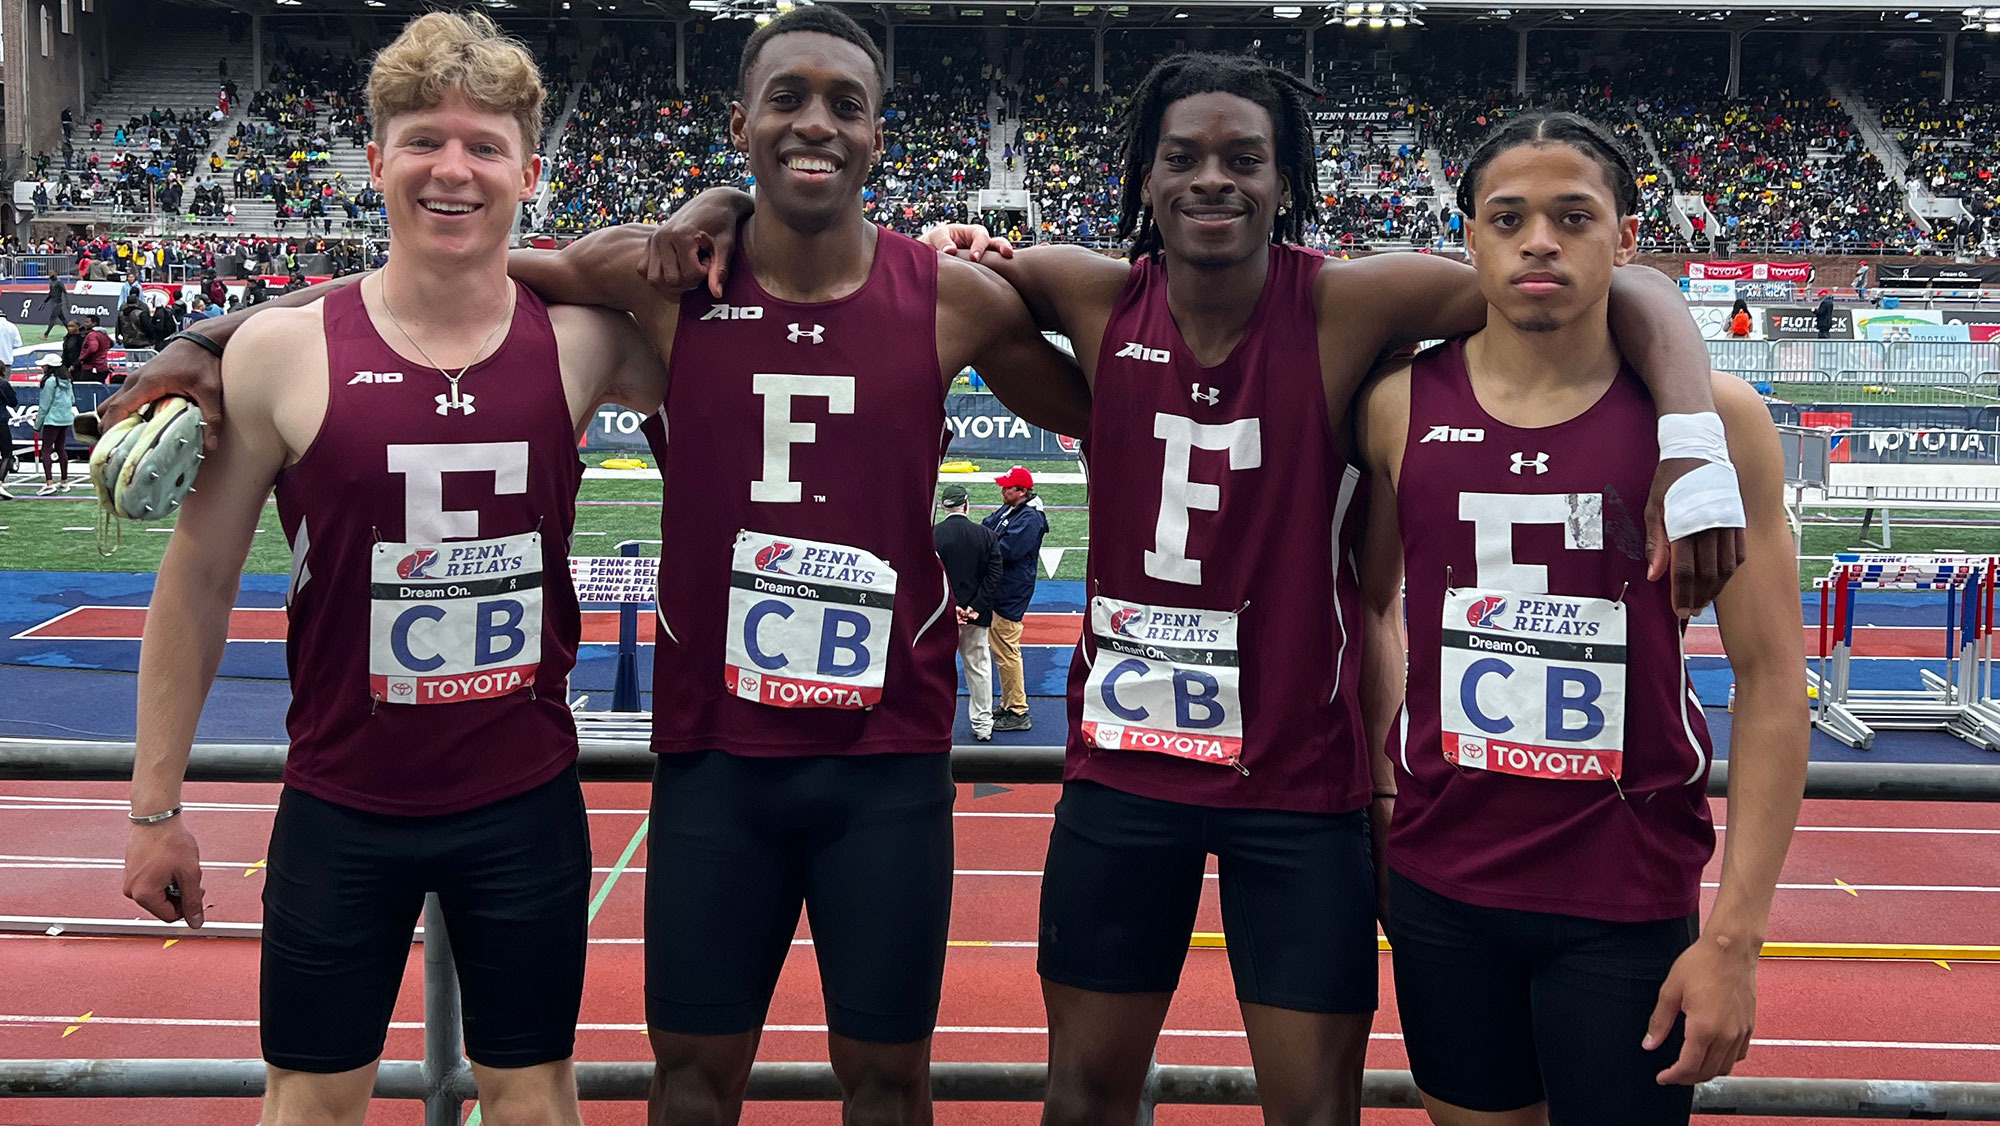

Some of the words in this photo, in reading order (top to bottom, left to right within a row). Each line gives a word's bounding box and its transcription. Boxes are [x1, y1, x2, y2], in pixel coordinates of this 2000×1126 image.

[1315, 112, 1344, 120] PENN
[1348, 112, 1389, 120] RELAYS
[1707, 268, 1742, 276] TOYOTA
[1771, 268, 1806, 276] TOYOTA
[70, 305, 96, 314] Dream
[700, 304, 764, 320] A10
[1781, 316, 1848, 328] FLOTRCK
[1115, 342, 1170, 364] A10
[347, 371, 404, 386] A10
[945, 416, 1031, 438] YOTA
[1420, 426, 1485, 442] A10
[751, 374, 856, 502] F
[387, 442, 529, 544] F
[1144, 412, 1262, 585] F
[449, 544, 506, 561] PENN
[1459, 492, 1604, 594] F
[445, 556, 522, 576] RELAYS
[802, 547, 860, 567] PENN
[590, 568, 624, 576] PENN
[634, 568, 656, 576] REL
[797, 562, 876, 584] RELAYS
[400, 587, 444, 598] Dream
[447, 586, 471, 596] On.
[624, 593, 655, 601] RELA
[755, 578, 794, 595] Dream
[796, 585, 820, 598] On.
[1516, 600, 1580, 618] PENN
[1150, 612, 1202, 627] PENN
[1513, 616, 1600, 636] RELAYS
[391, 604, 446, 672] C
[474, 600, 525, 666] B
[744, 600, 794, 670] C
[816, 608, 871, 678] B
[1145, 628, 1218, 642] RELAYS
[1468, 635, 1512, 653] Dream
[1515, 641, 1540, 655] On.
[1112, 642, 1145, 657] Dream
[1146, 646, 1170, 660] On.
[423, 671, 522, 698] TOYOTA
[766, 681, 864, 707] TOYOTA
[1101, 659, 1150, 722] C
[1173, 668, 1225, 728] B
[1460, 658, 1514, 734] C
[1546, 666, 1604, 742] B
[1129, 731, 1223, 758] TOYOTA
[1493, 746, 1604, 775] TOYOTA
